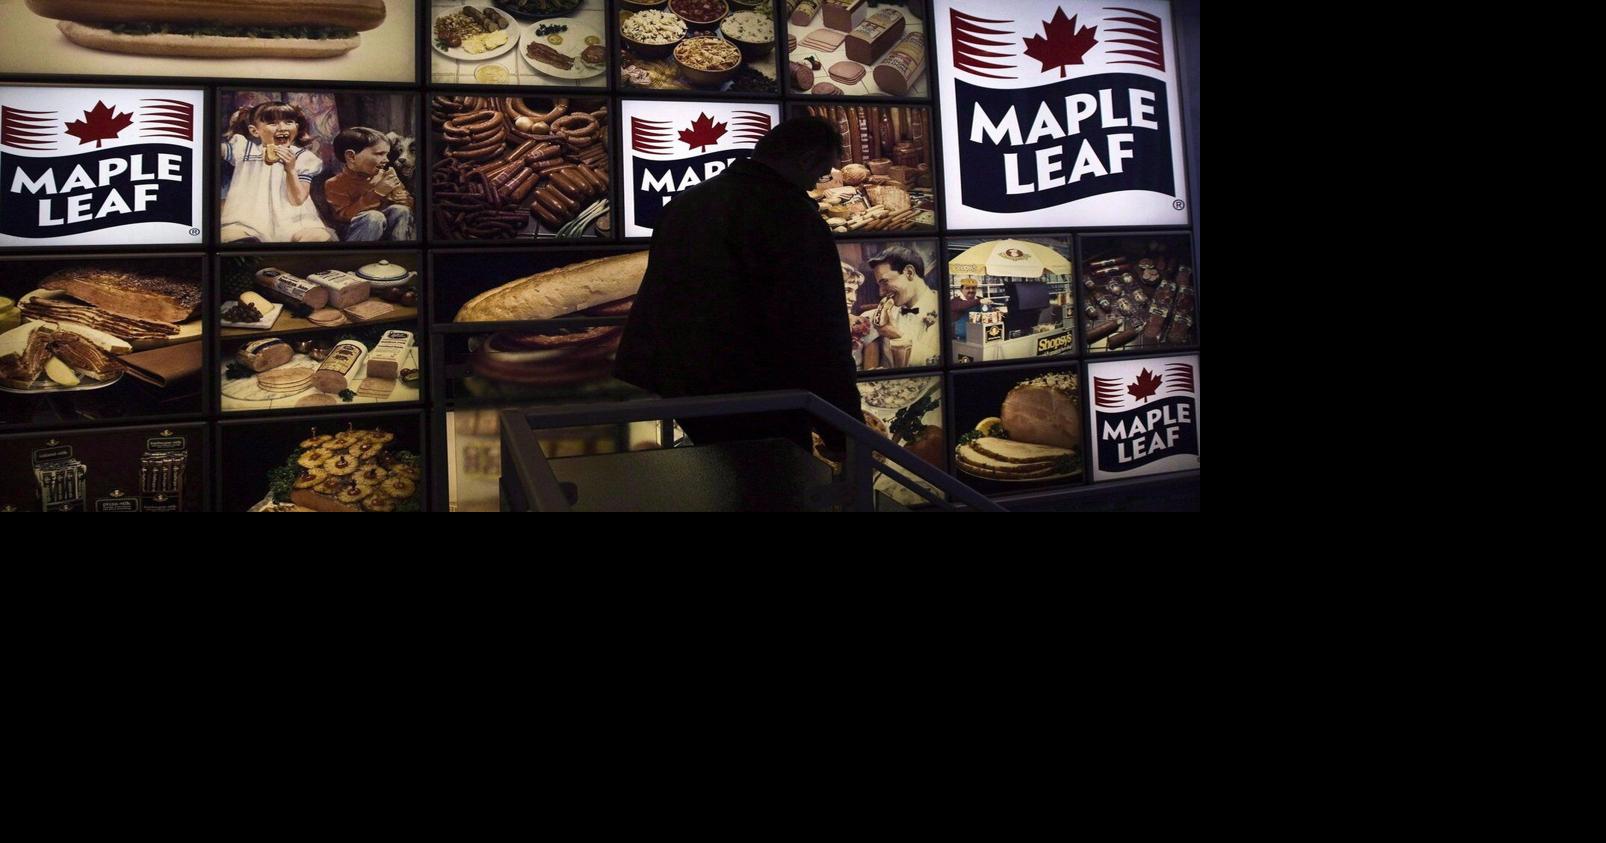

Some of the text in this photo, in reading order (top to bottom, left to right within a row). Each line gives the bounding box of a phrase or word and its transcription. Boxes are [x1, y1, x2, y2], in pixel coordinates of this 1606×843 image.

[969, 88, 1159, 147] MAPLE
[10, 153, 183, 195] MAPLE
[640, 158, 752, 193] MAP
[1003, 134, 1134, 195] LEAF
[38, 183, 159, 227] LEAF
[1102, 403, 1191, 440] MAPLE
[1117, 426, 1180, 464] LEAF
